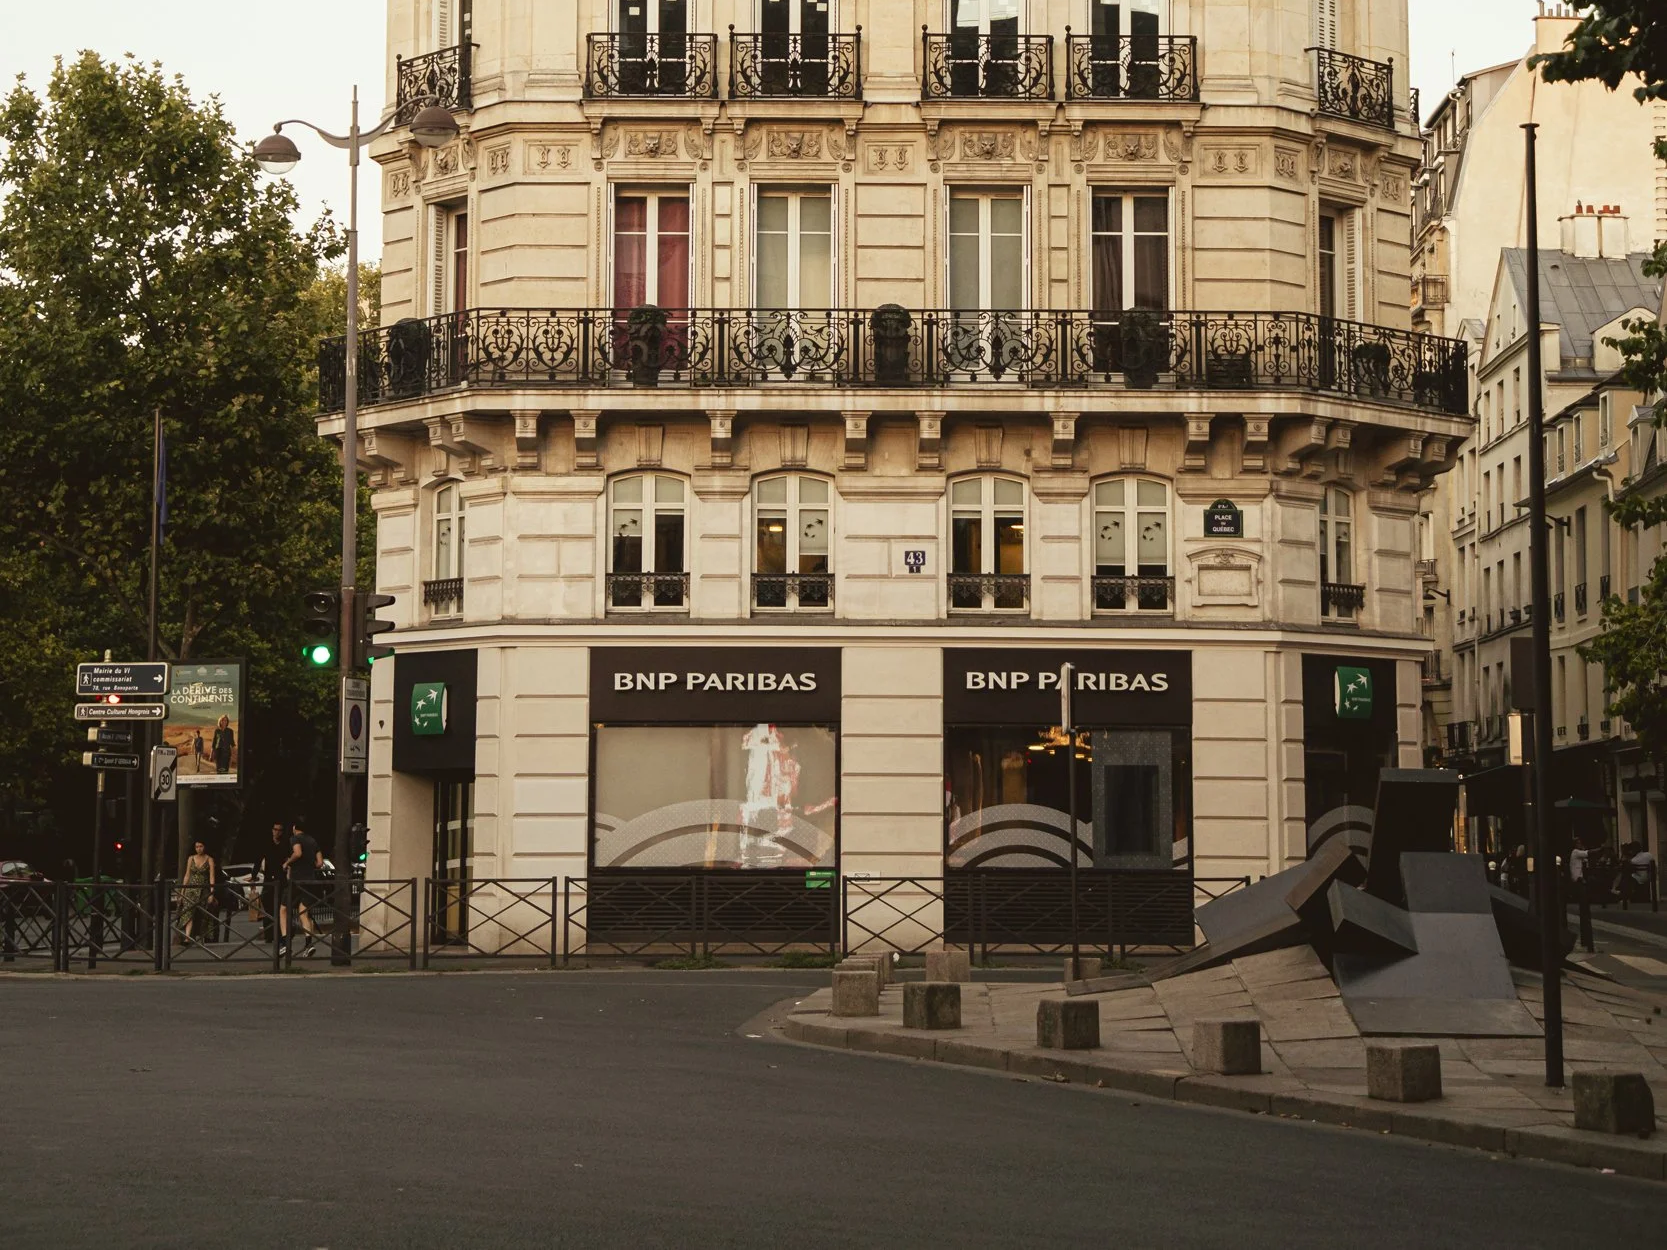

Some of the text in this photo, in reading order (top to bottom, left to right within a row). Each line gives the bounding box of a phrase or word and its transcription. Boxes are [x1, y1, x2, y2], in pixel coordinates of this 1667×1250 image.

[907, 552, 923, 564] 43
[92, 675, 132, 683] commissariat
[614, 672, 817, 692] BNP PARIBAS
[966, 671, 1030, 690] BNP
[170, 694, 234, 704] CONTINENTS
[127, 708, 150, 716] Hongrois
[161, 774, 170, 785] 30
